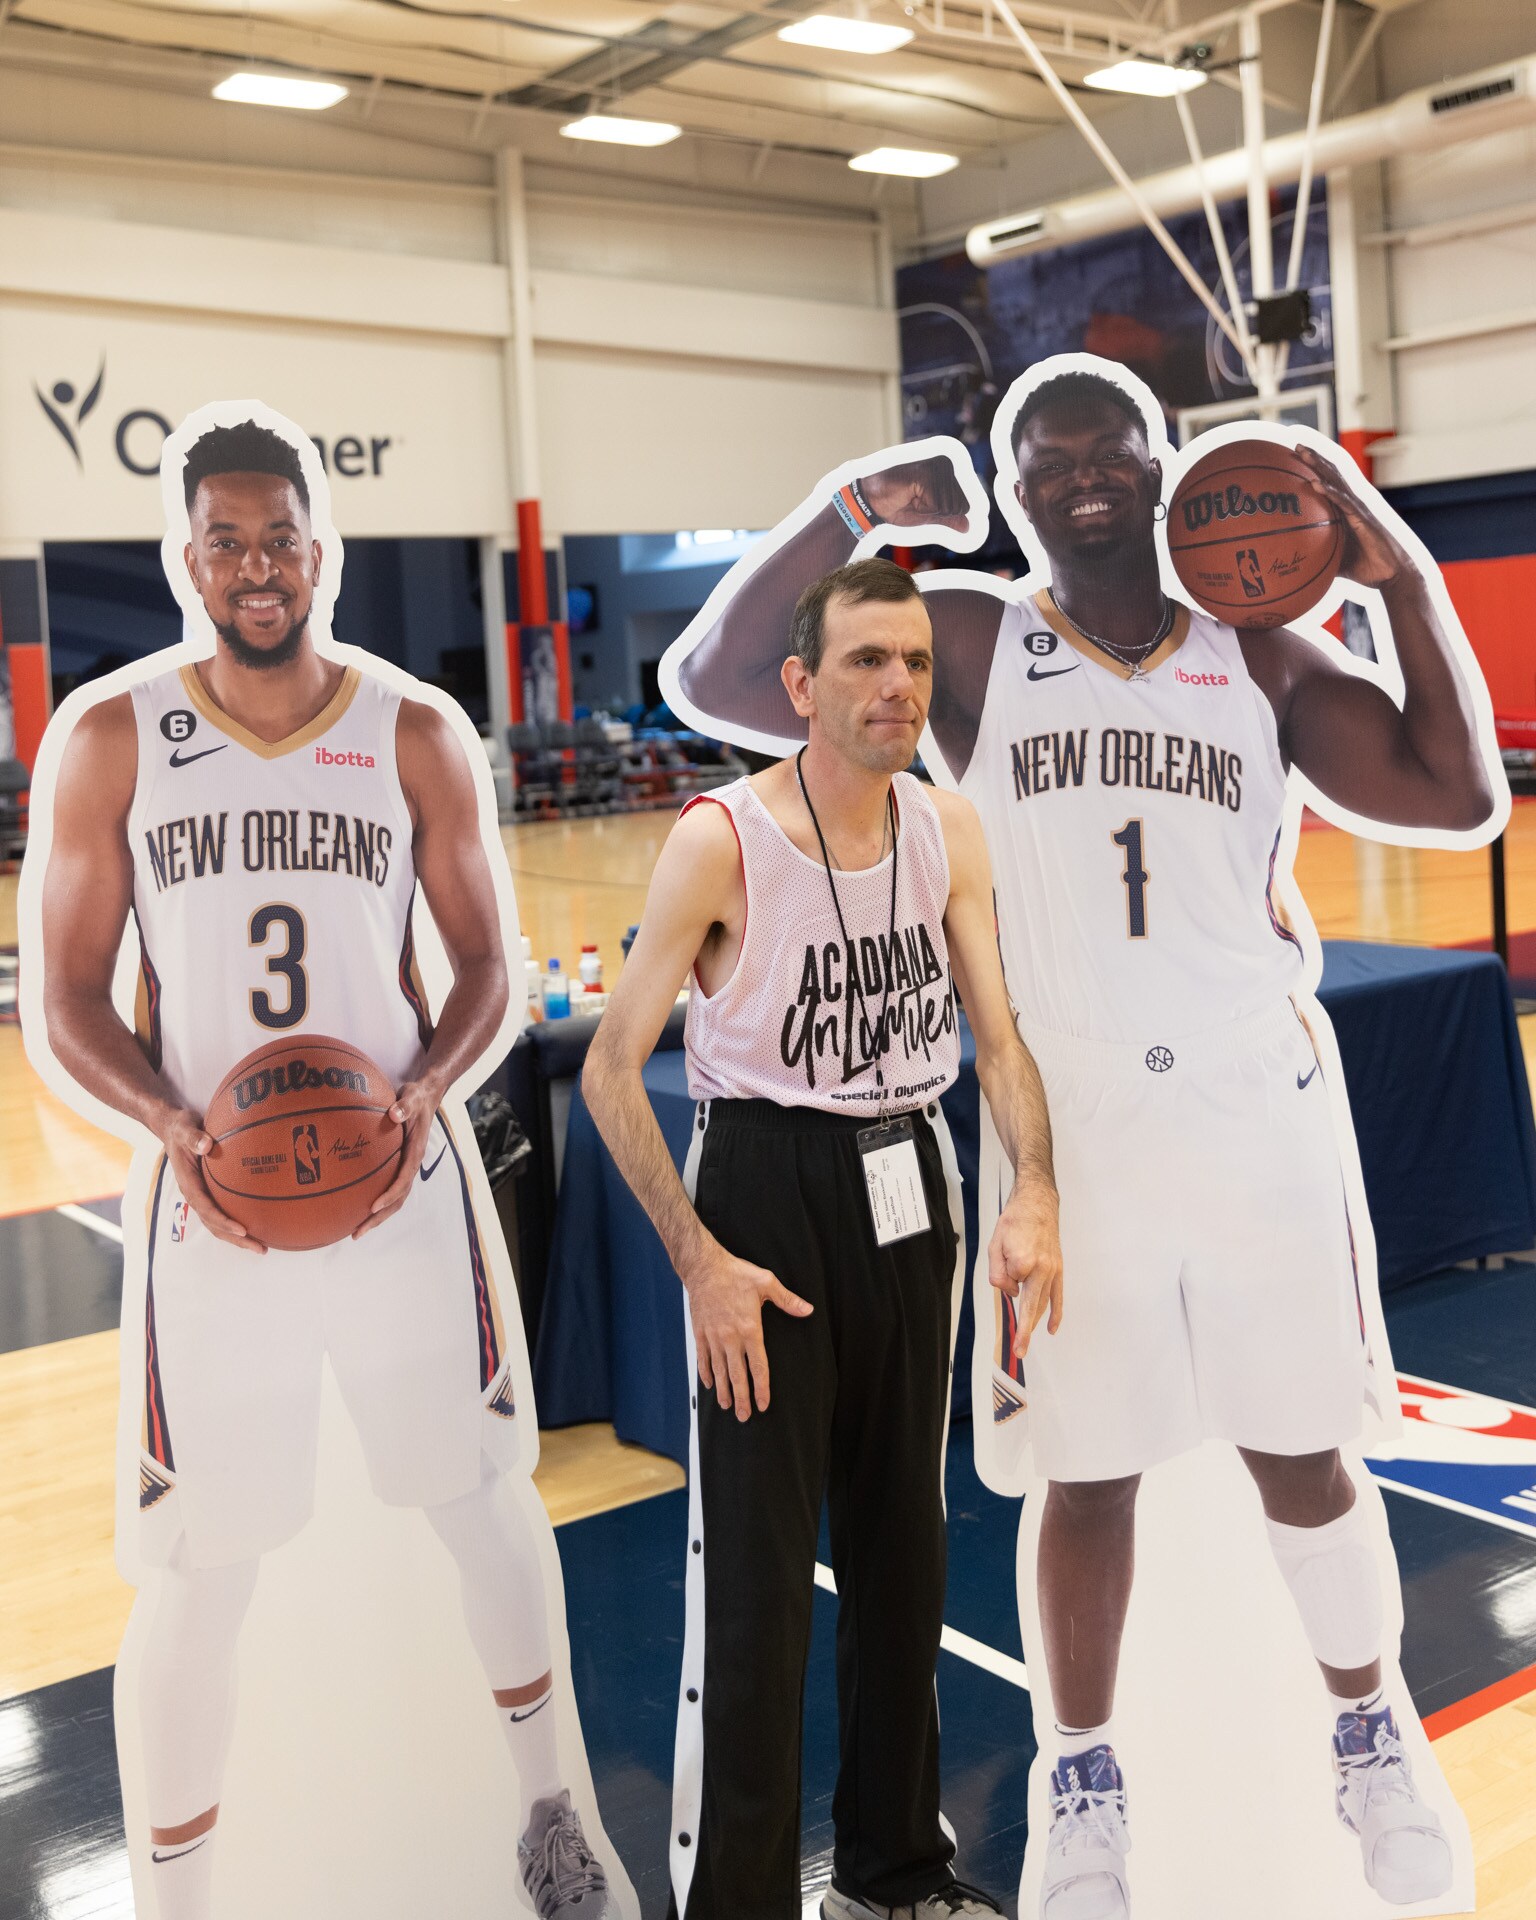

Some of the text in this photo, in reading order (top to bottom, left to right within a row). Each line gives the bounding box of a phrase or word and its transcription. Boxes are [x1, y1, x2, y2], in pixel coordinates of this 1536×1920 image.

[1181, 484, 1302, 532] Wilson
[1031, 635, 1050, 653] 6
[1174, 666, 1230, 686] ibotta
[168, 714, 190, 738] 6
[315, 747, 376, 769] ibotta
[1010, 728, 1243, 813] NEW ORLEANS
[145, 809, 393, 893] NEW ORLEANS
[1110, 816, 1151, 940] 1
[248, 901, 311, 1033] 3
[231, 1059, 371, 1112] Wilson
[894, 1073, 946, 1098] Olympics
